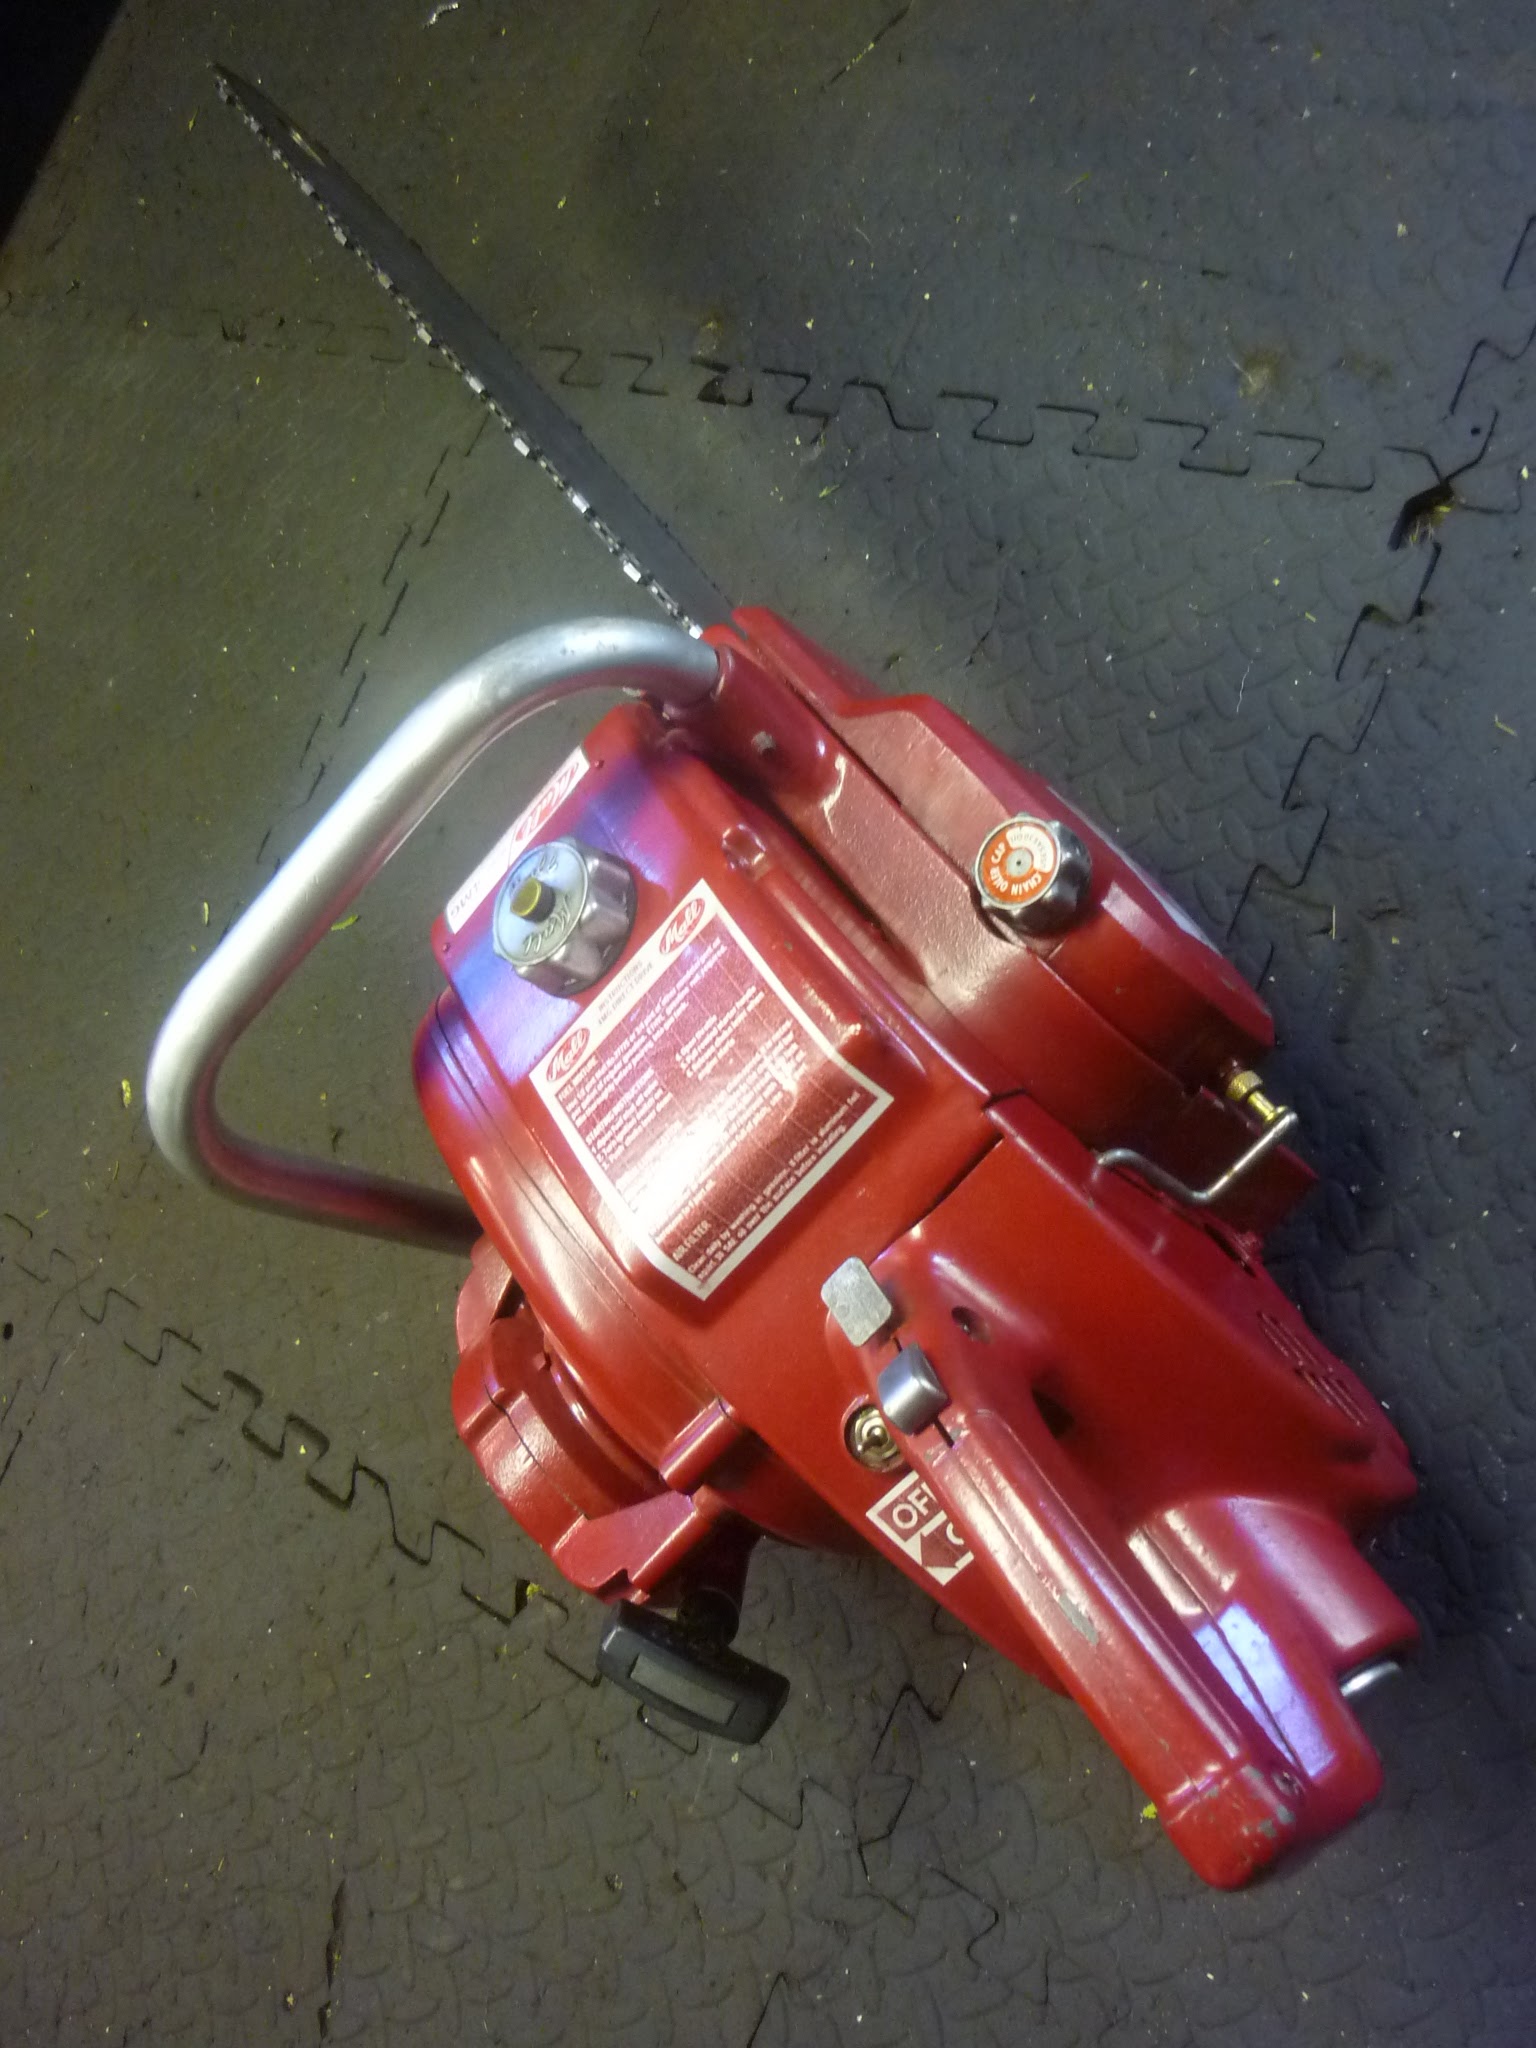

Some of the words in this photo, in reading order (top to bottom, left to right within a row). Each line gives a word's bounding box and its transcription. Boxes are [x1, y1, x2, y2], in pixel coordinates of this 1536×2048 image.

[991, 842, 1005, 864] CAP
[990, 866, 1009, 892] OILER
[1011, 874, 1042, 895] CHAIN
[659, 899, 703, 952] Mall
[549, 1030, 589, 1078] Mall
[557, 1083, 573, 1101] FUEL
[570, 1055, 598, 1087] MIXTURE
[671, 1242, 688, 1262] AIR
[682, 1217, 712, 1250] FILTER
